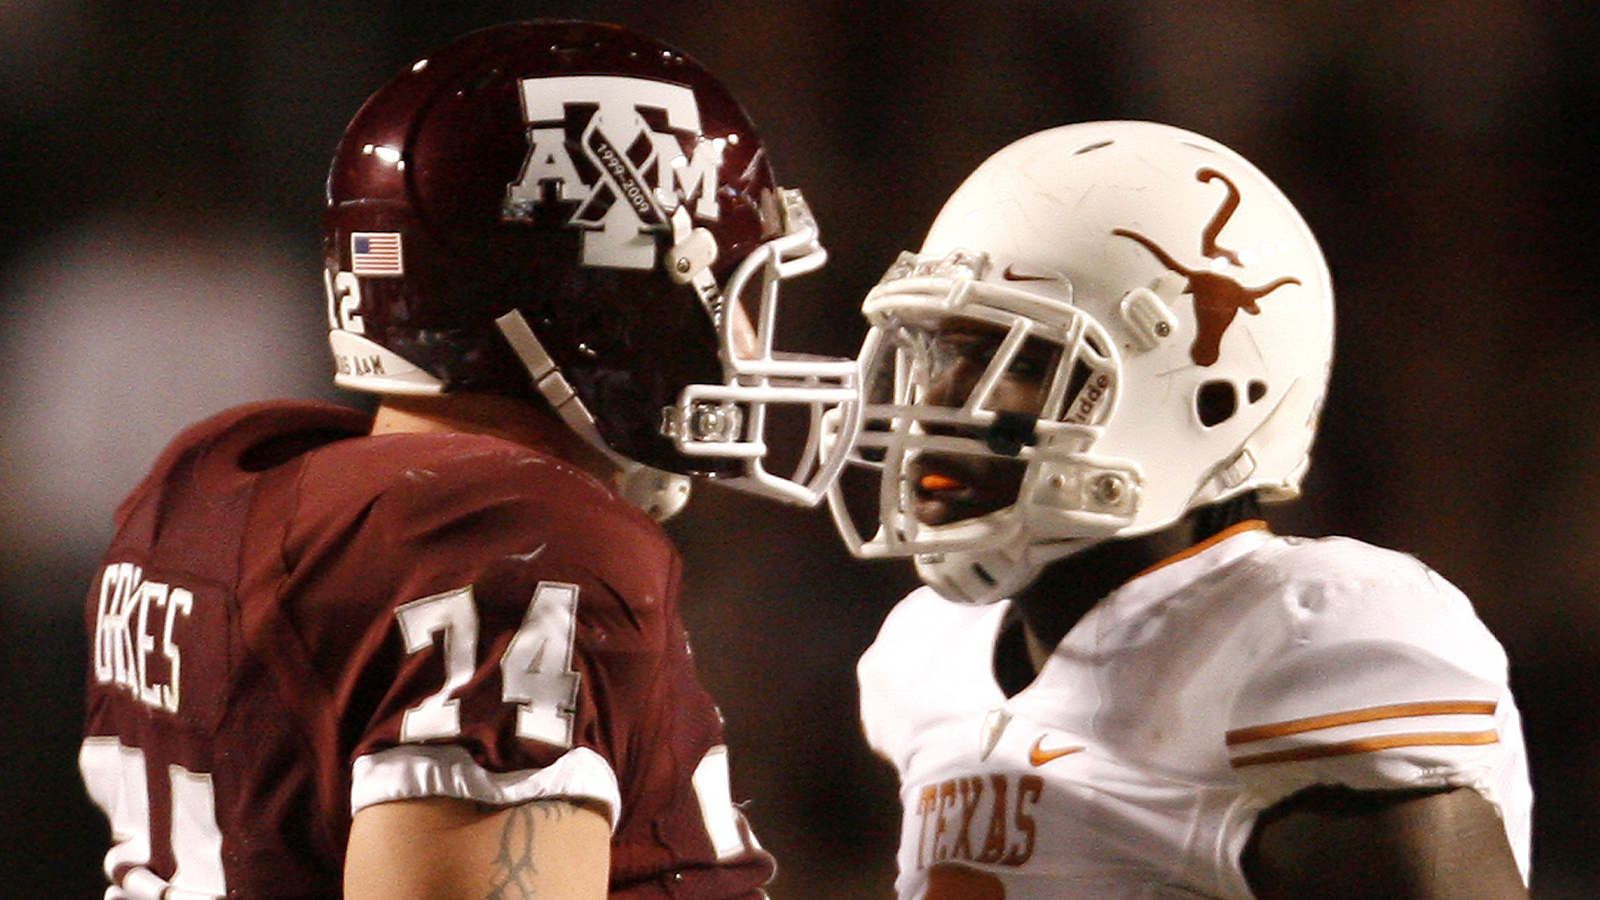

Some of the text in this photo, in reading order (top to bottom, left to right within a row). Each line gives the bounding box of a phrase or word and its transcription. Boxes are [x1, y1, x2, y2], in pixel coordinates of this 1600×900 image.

[597, 143, 649, 212] 1999-2009
[1195, 166, 1245, 268] 2
[393, 580, 581, 749] 74
[917, 772, 1044, 870] TEXAS
